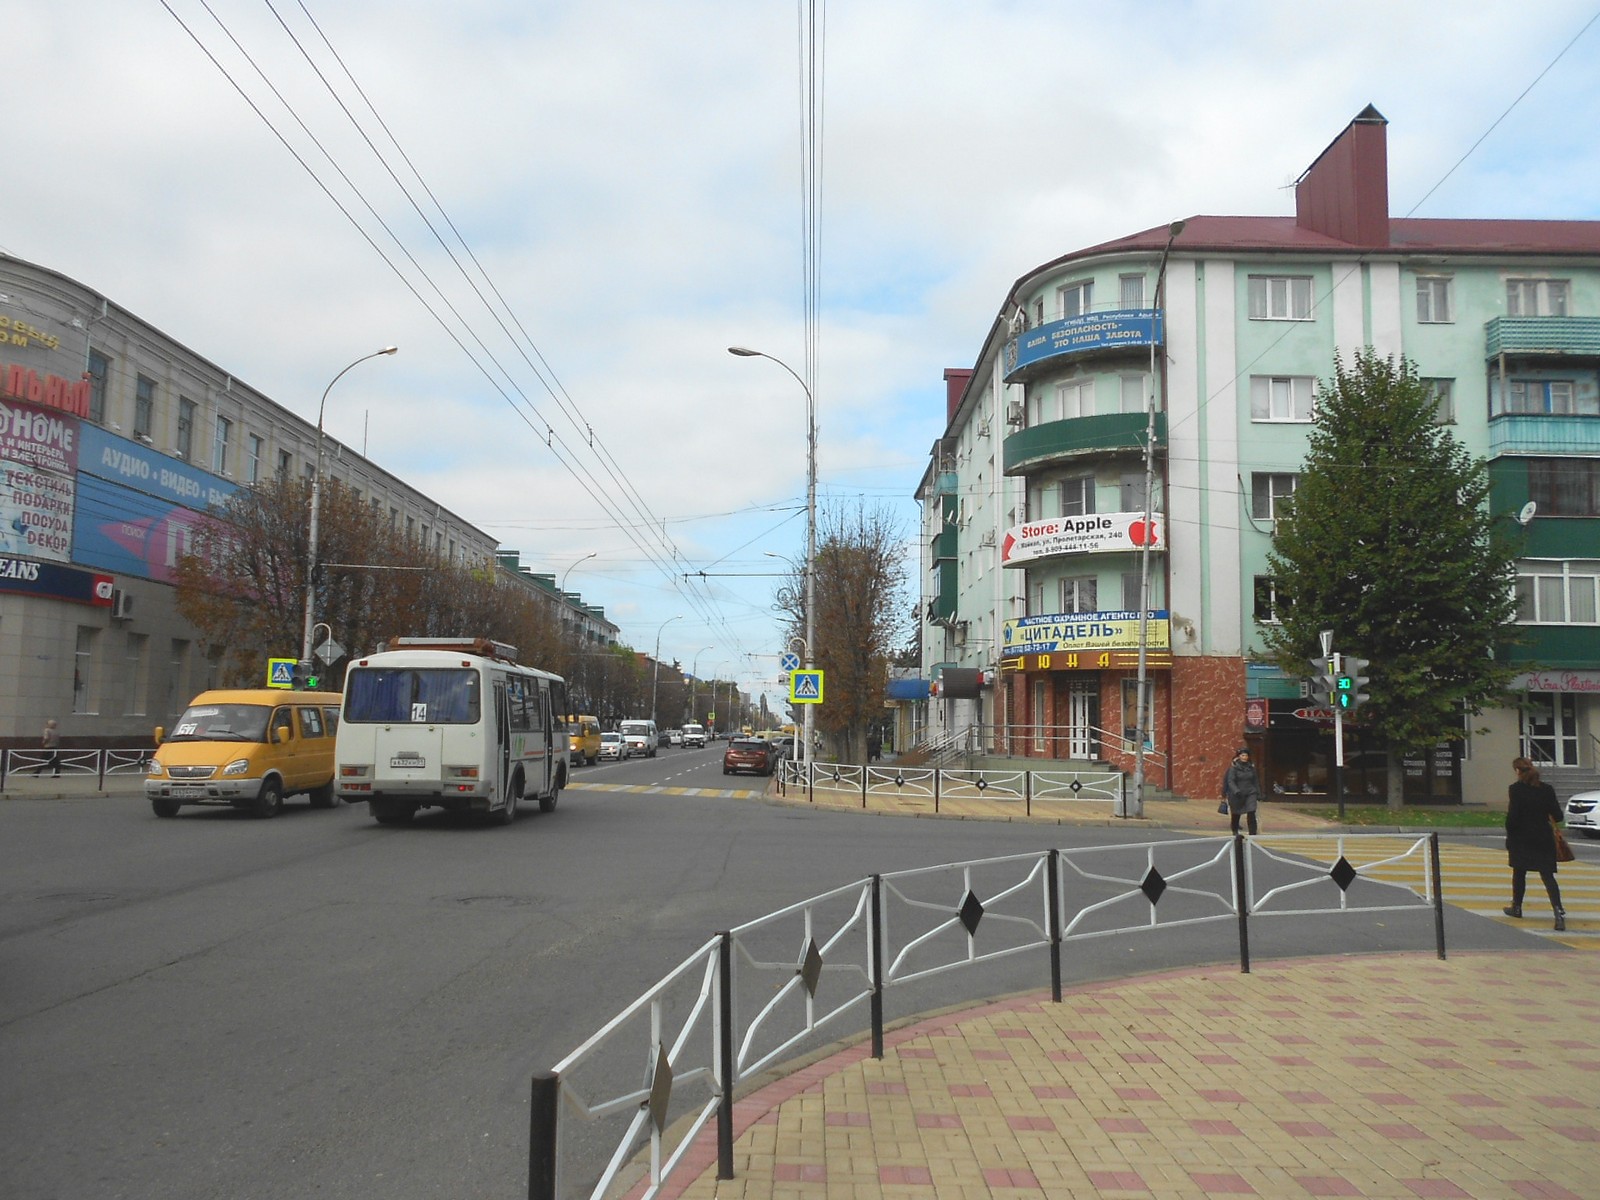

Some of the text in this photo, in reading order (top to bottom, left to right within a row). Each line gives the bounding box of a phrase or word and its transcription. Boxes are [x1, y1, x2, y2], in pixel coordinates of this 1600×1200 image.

[1027, 336, 1047, 348] ВАША
[1054, 330, 1142, 349] ЭТО НАША ЗАБОТА
[18, 440, 64, 460] ИНТЕРЬЕРА
[102, 447, 149, 480] АУДИО
[160, 468, 200, 498] ВИДЕО
[6, 469, 71, 496] ТЕКСТИЛЬ
[121, 523, 146, 538] ПОИСК
[1021, 517, 1112, 539] Store: Apple
[1052, 533, 1106, 545] Пролетарская,
[1108, 531, 1123, 540] 240
[1024, 615, 1053, 627] ЧАСТНОЕ
[1054, 611, 1099, 624] ОХРАННОЕ
[1063, 641, 1084, 649] Оплот
[1086, 640, 1110, 648] Вашей
[307, 677, 317, 687] 30
[1338, 678, 1351, 689] 30
[412, 705, 425, 721] 14
